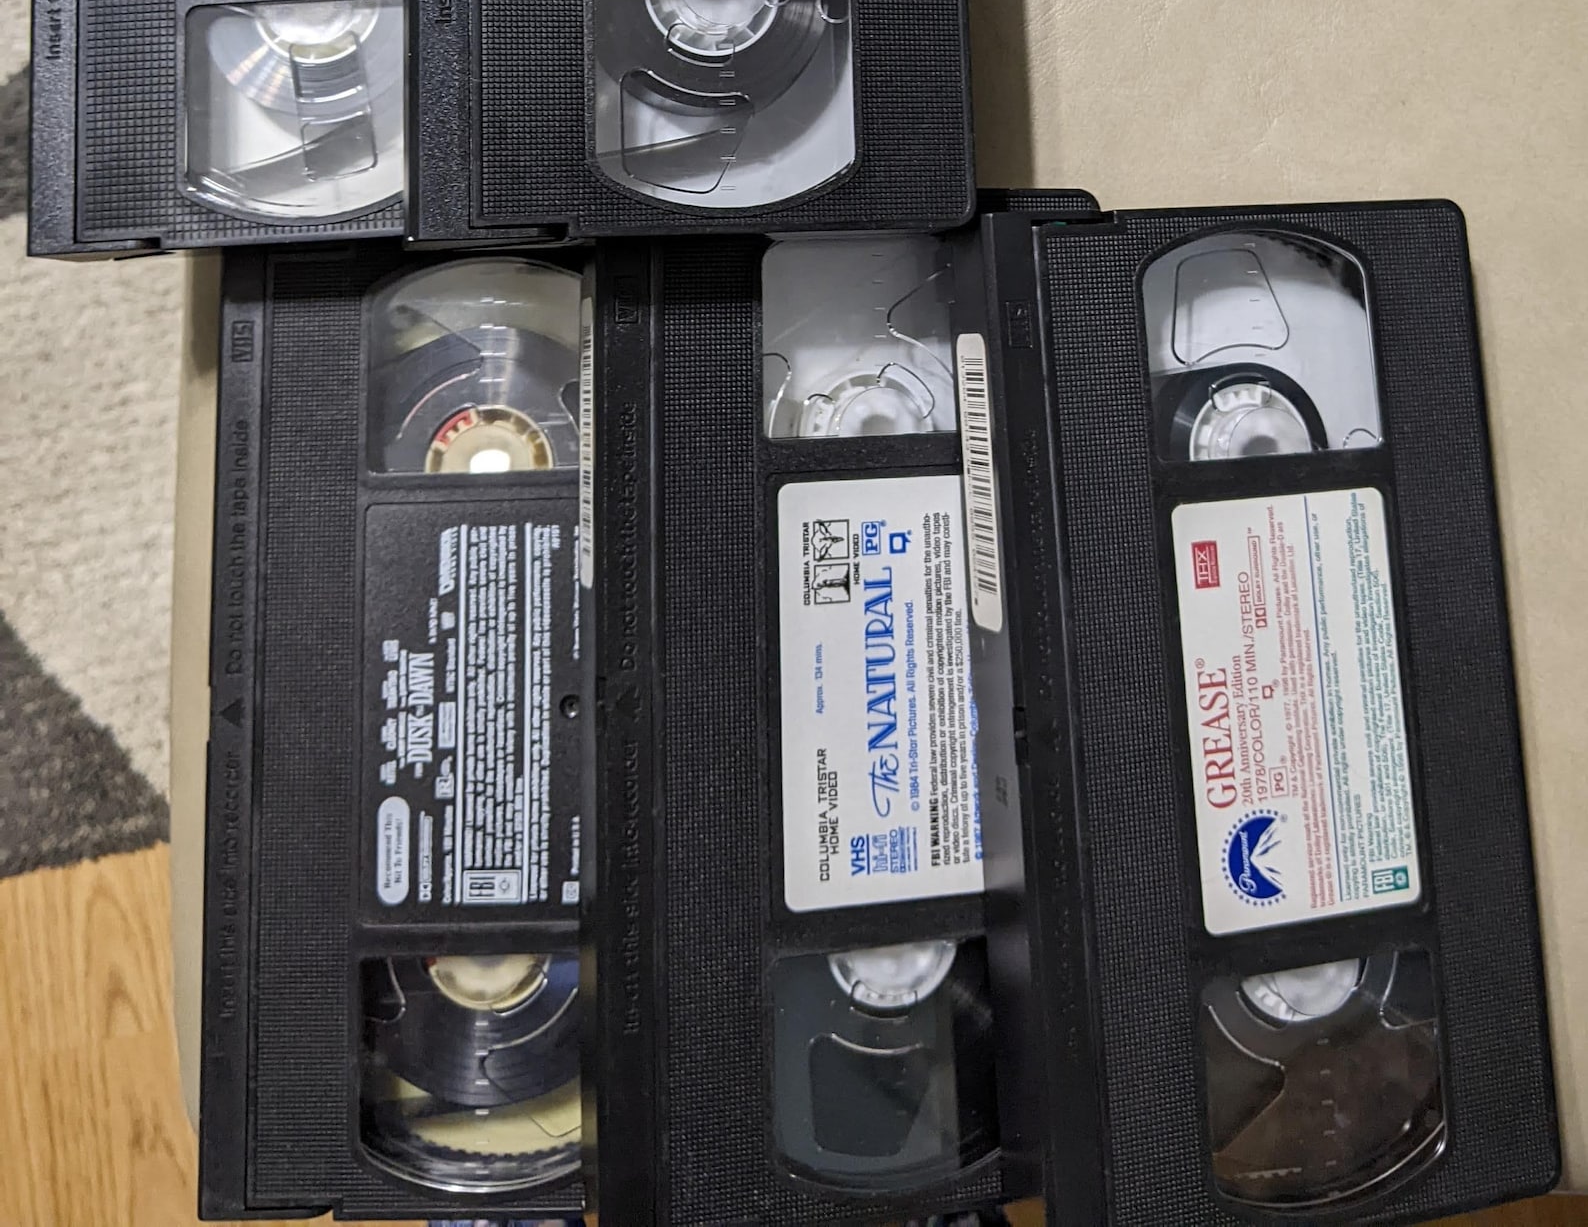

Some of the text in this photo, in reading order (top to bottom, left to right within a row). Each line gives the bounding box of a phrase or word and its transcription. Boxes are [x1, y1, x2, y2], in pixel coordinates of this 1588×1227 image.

[44, 8, 64, 61] Insert
[866, 523, 879, 552] PG
[407, 652, 435, 763] DUSK DAWN
[863, 565, 900, 818] The NATURAL
[904, 602, 920, 812] © 1984 Tri-Star Pictures. All Rights Reserved.
[1237, 572, 1268, 803] 1978/COLOR/110 MIN./STEREO
[1230, 655, 1253, 805] 20th Anniversary Edition
[827, 772, 839, 855] HOME VIDEO
[1273, 771, 1284, 793] PG
[816, 749, 830, 882] COLUMBIA TRISTAR
[851, 835, 866, 876] VHS
[889, 829, 899, 874] STEREO
[1237, 830, 1255, 893] Paramount
[1375, 871, 1392, 890] FBI
[469, 874, 495, 898] FBI
